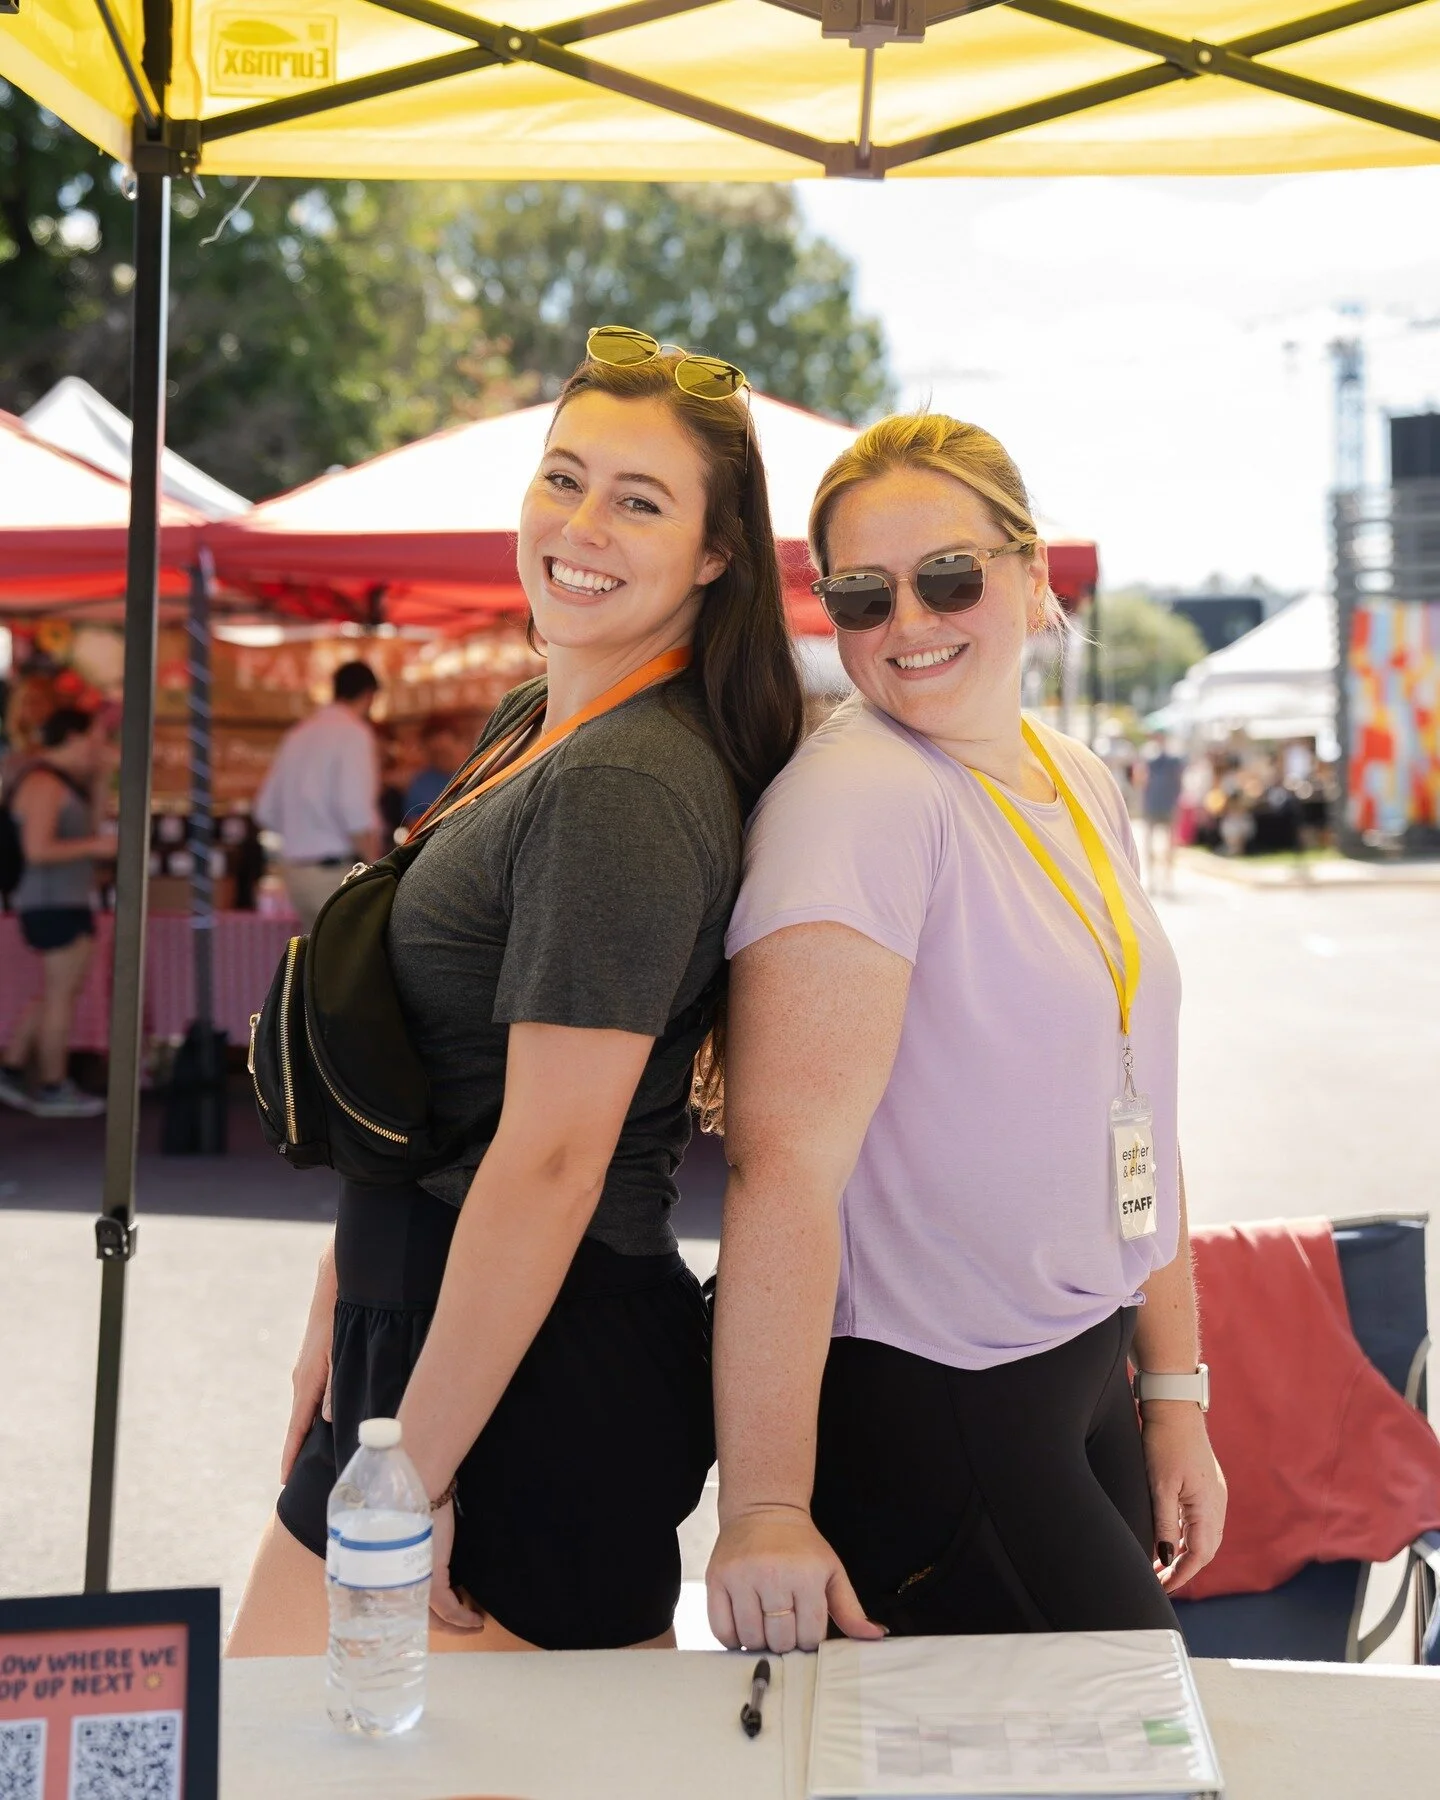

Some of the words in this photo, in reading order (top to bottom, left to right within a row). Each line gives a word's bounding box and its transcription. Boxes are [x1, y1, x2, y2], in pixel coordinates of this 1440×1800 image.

[1122, 1145, 1149, 1161] esther
[1123, 1165, 1128, 1178] &
[1130, 1162, 1146, 1176] elsa
[1122, 1196, 1152, 1215] STAFF
[47, 1649, 132, 1672] WHERE
[140, 1646, 176, 1667] WE
[34, 1678, 64, 1699] UP
[72, 1673, 135, 1696] NEXT
